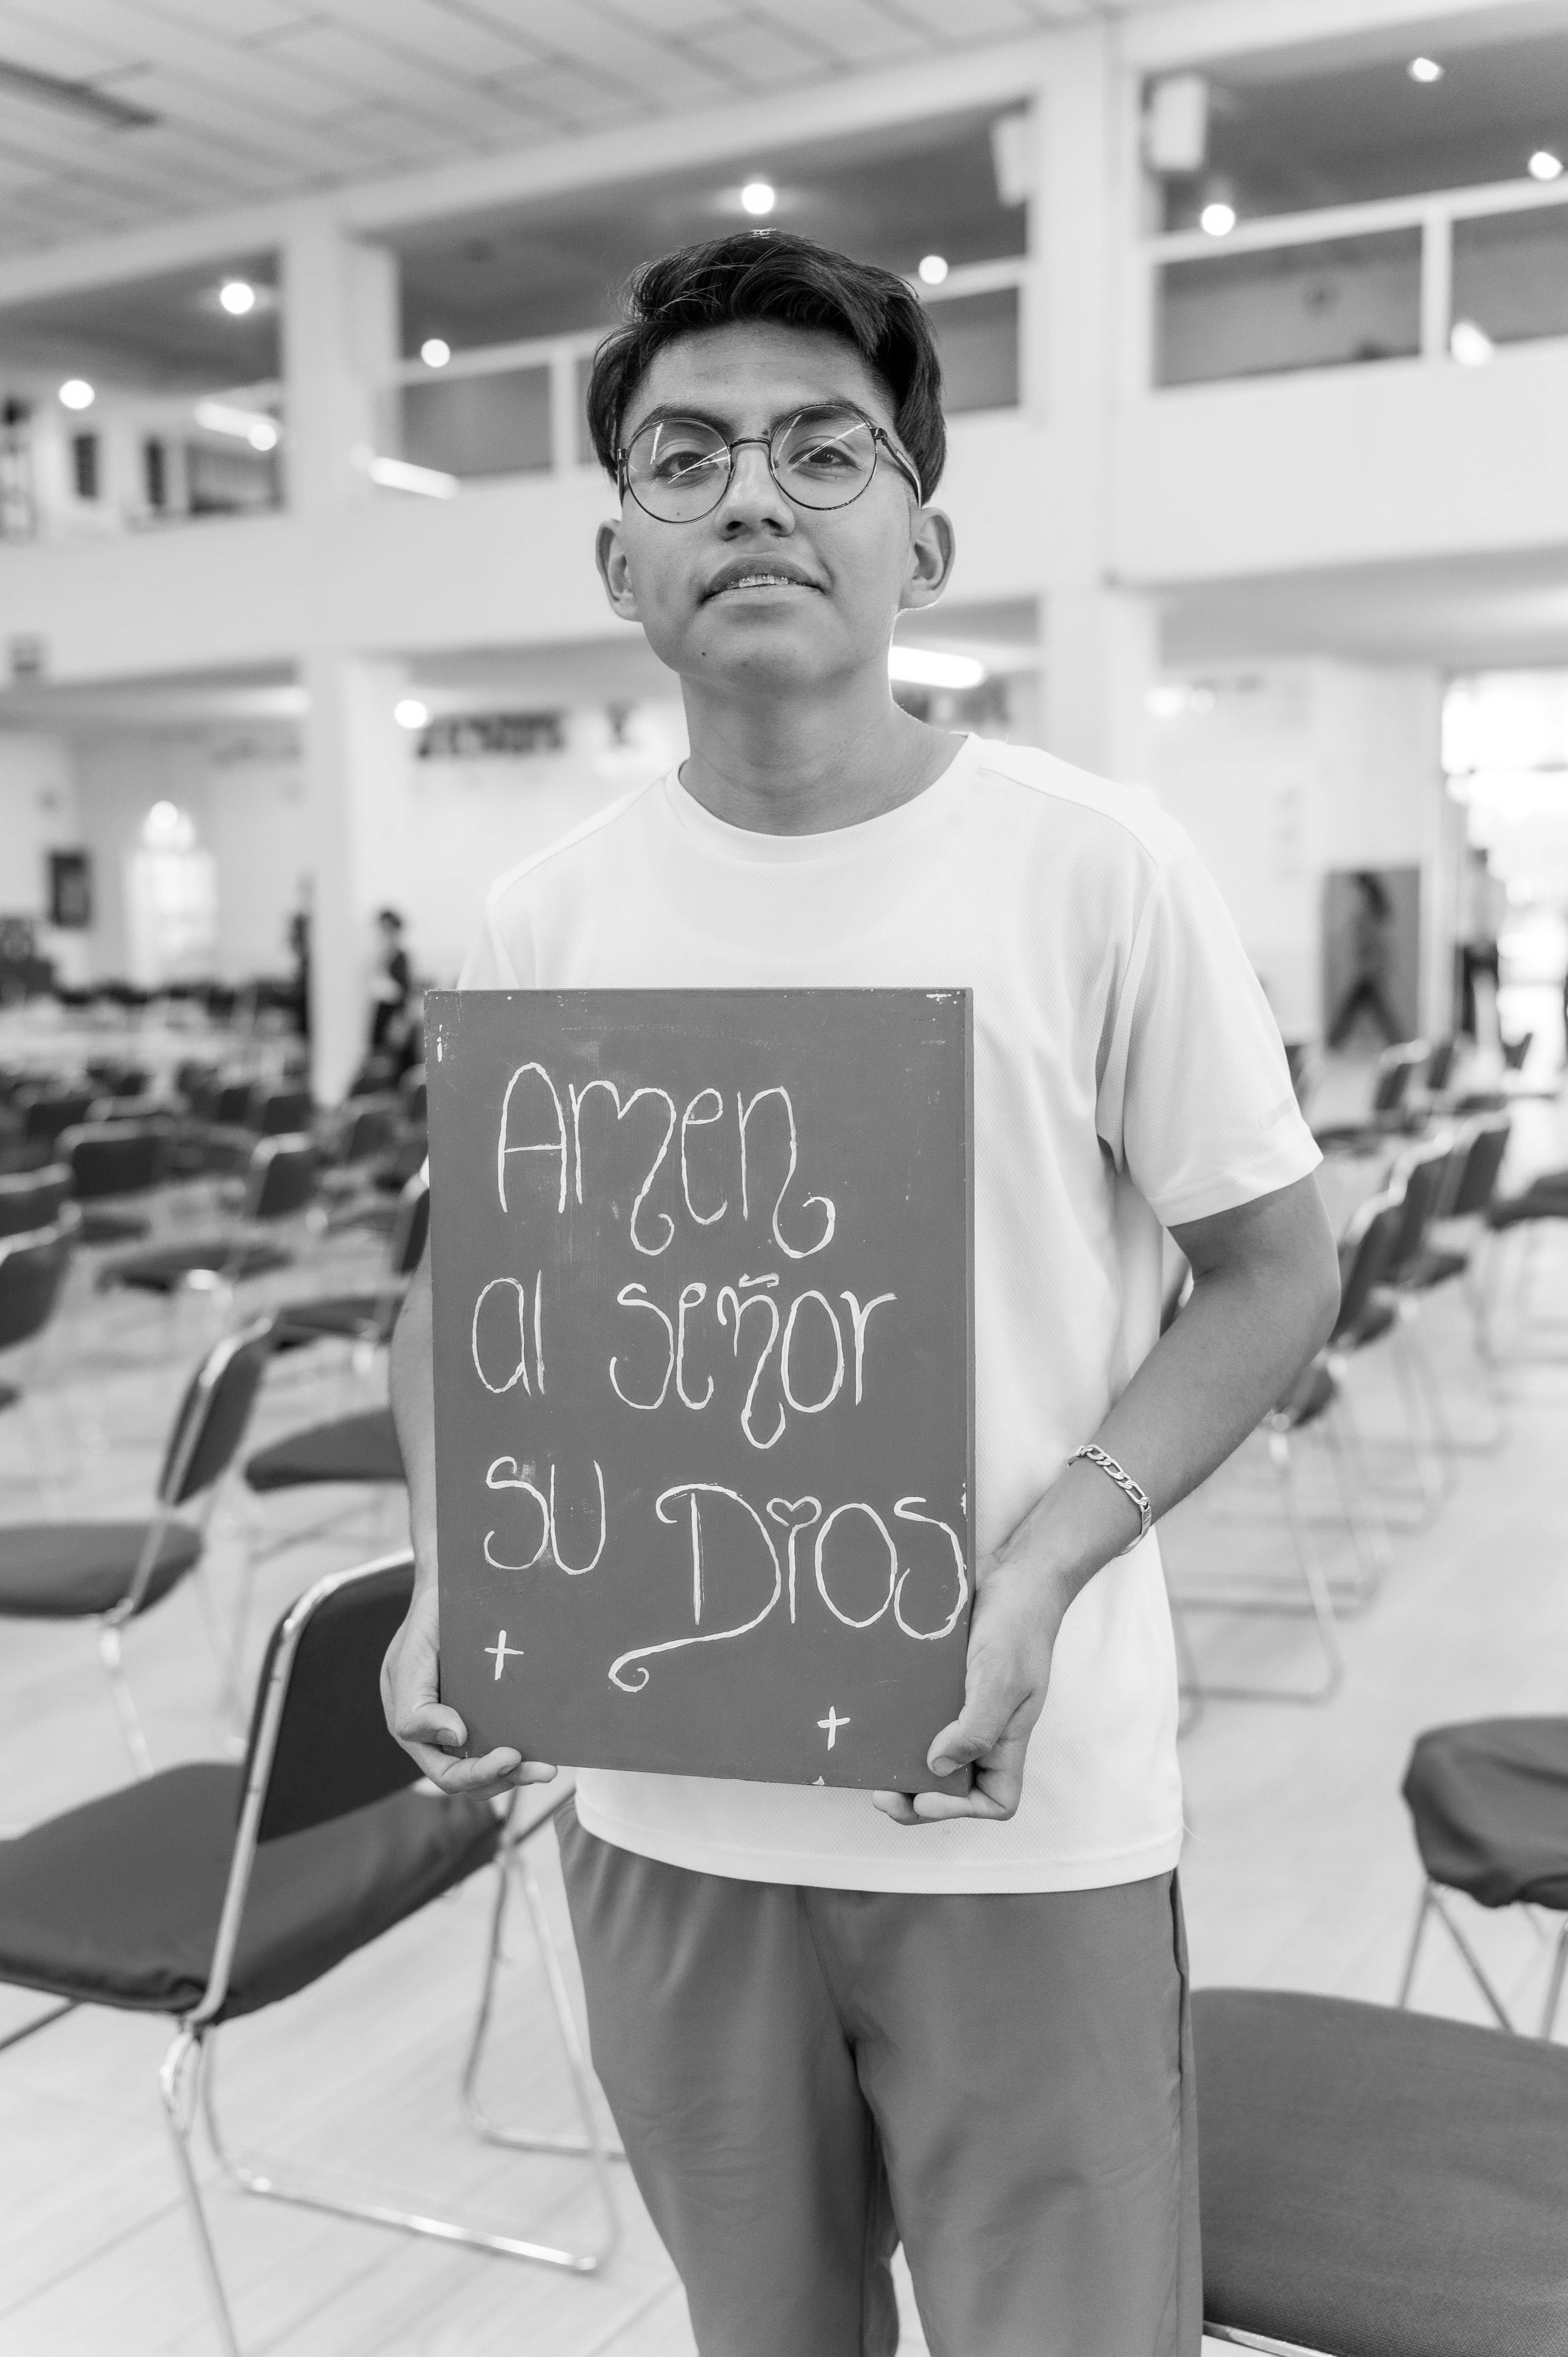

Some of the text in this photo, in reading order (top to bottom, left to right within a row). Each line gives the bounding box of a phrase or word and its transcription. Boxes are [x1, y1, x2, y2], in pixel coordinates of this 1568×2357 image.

[497, 1061, 836, 1259] Amen
[471, 1269, 546, 1397] al
[608, 1483, 969, 1693] Dios
